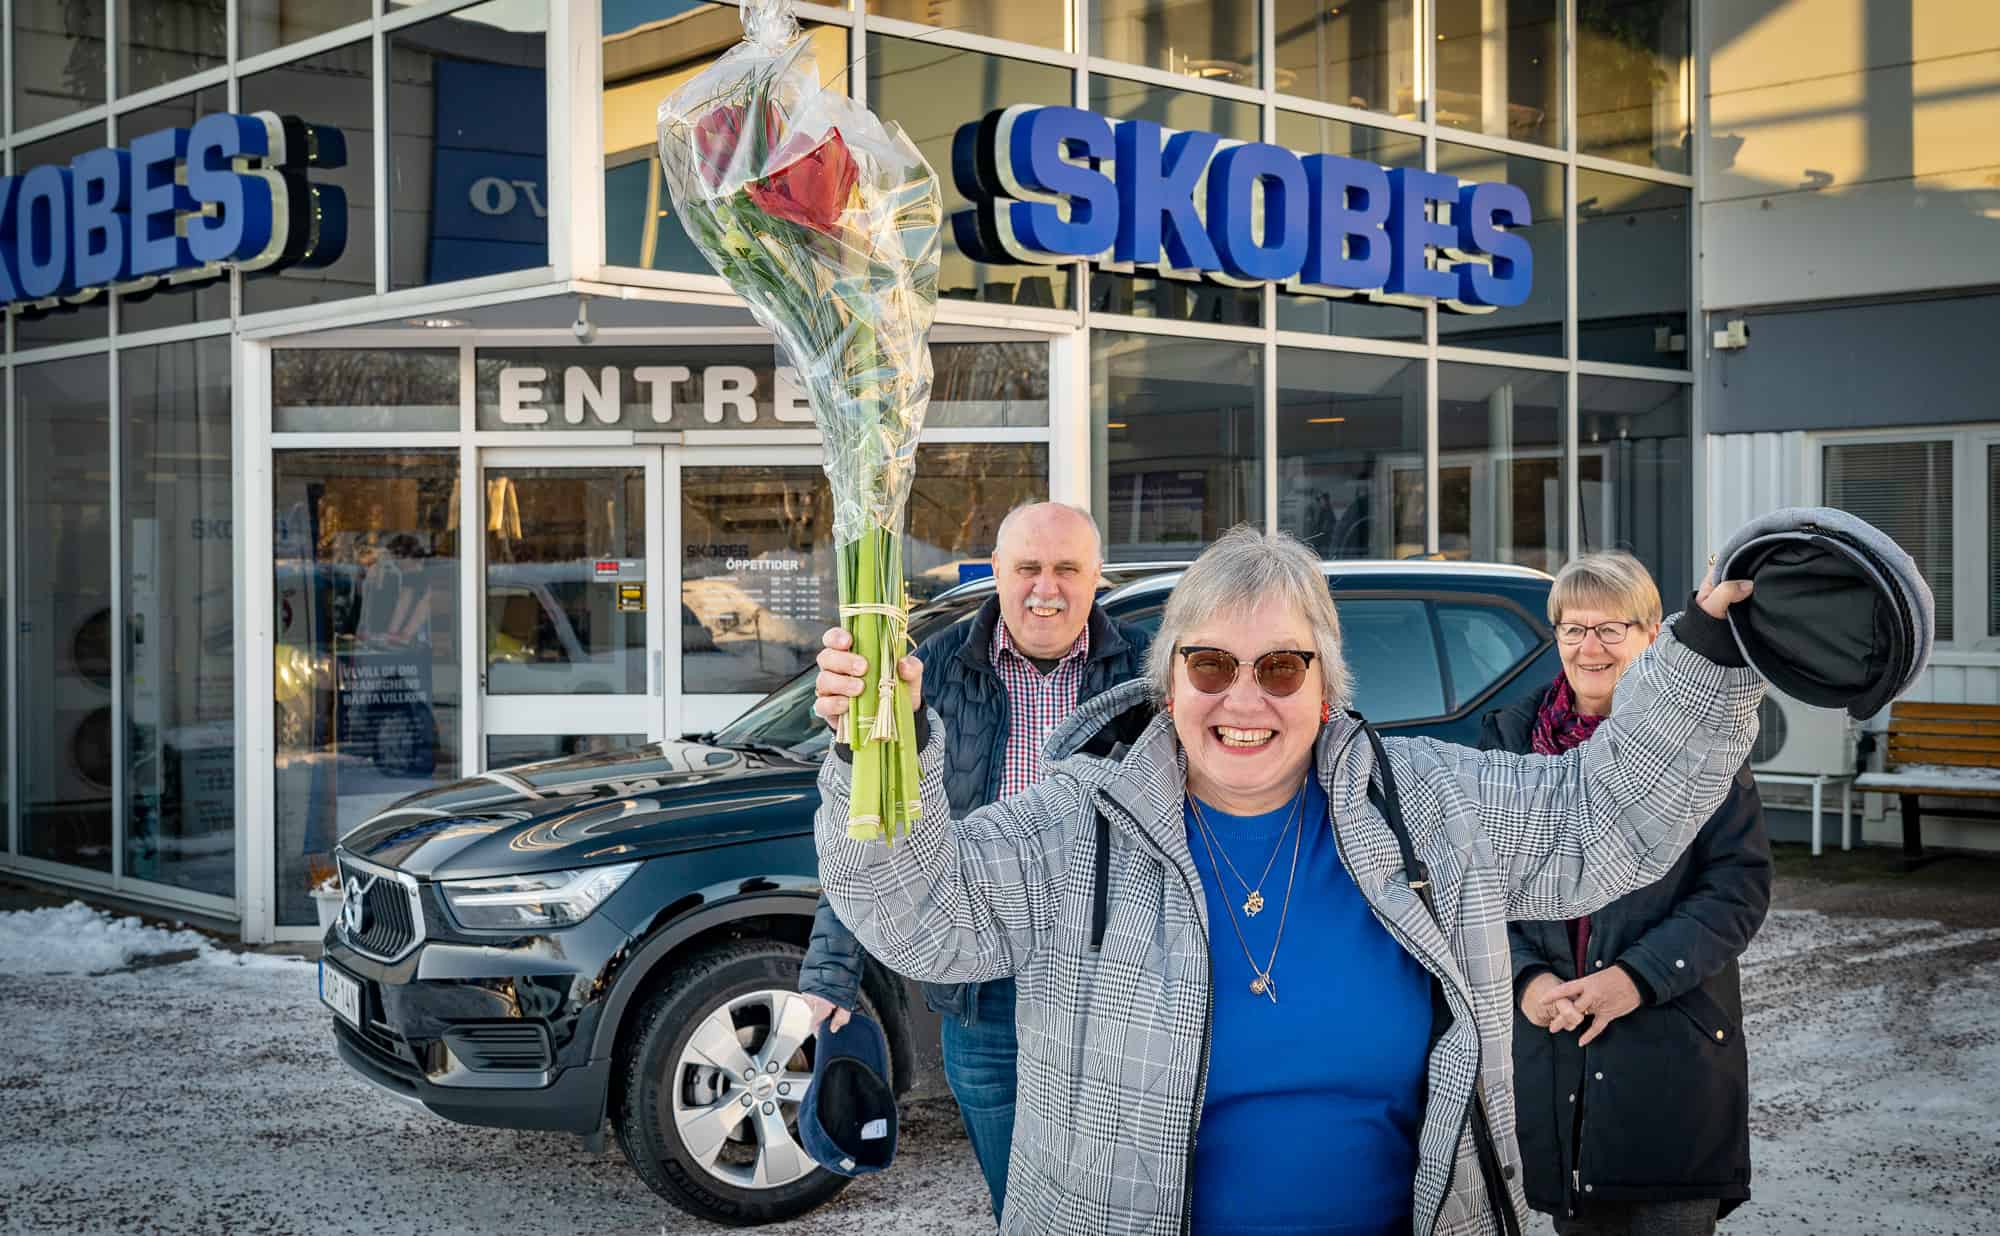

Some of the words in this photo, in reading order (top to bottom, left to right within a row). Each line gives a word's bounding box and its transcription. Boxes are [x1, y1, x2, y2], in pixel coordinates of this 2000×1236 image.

[0, 112, 262, 302] OBES
[1009, 106, 1533, 308] SKOBES
[725, 557, 800, 571] ÖPPETTIDER
